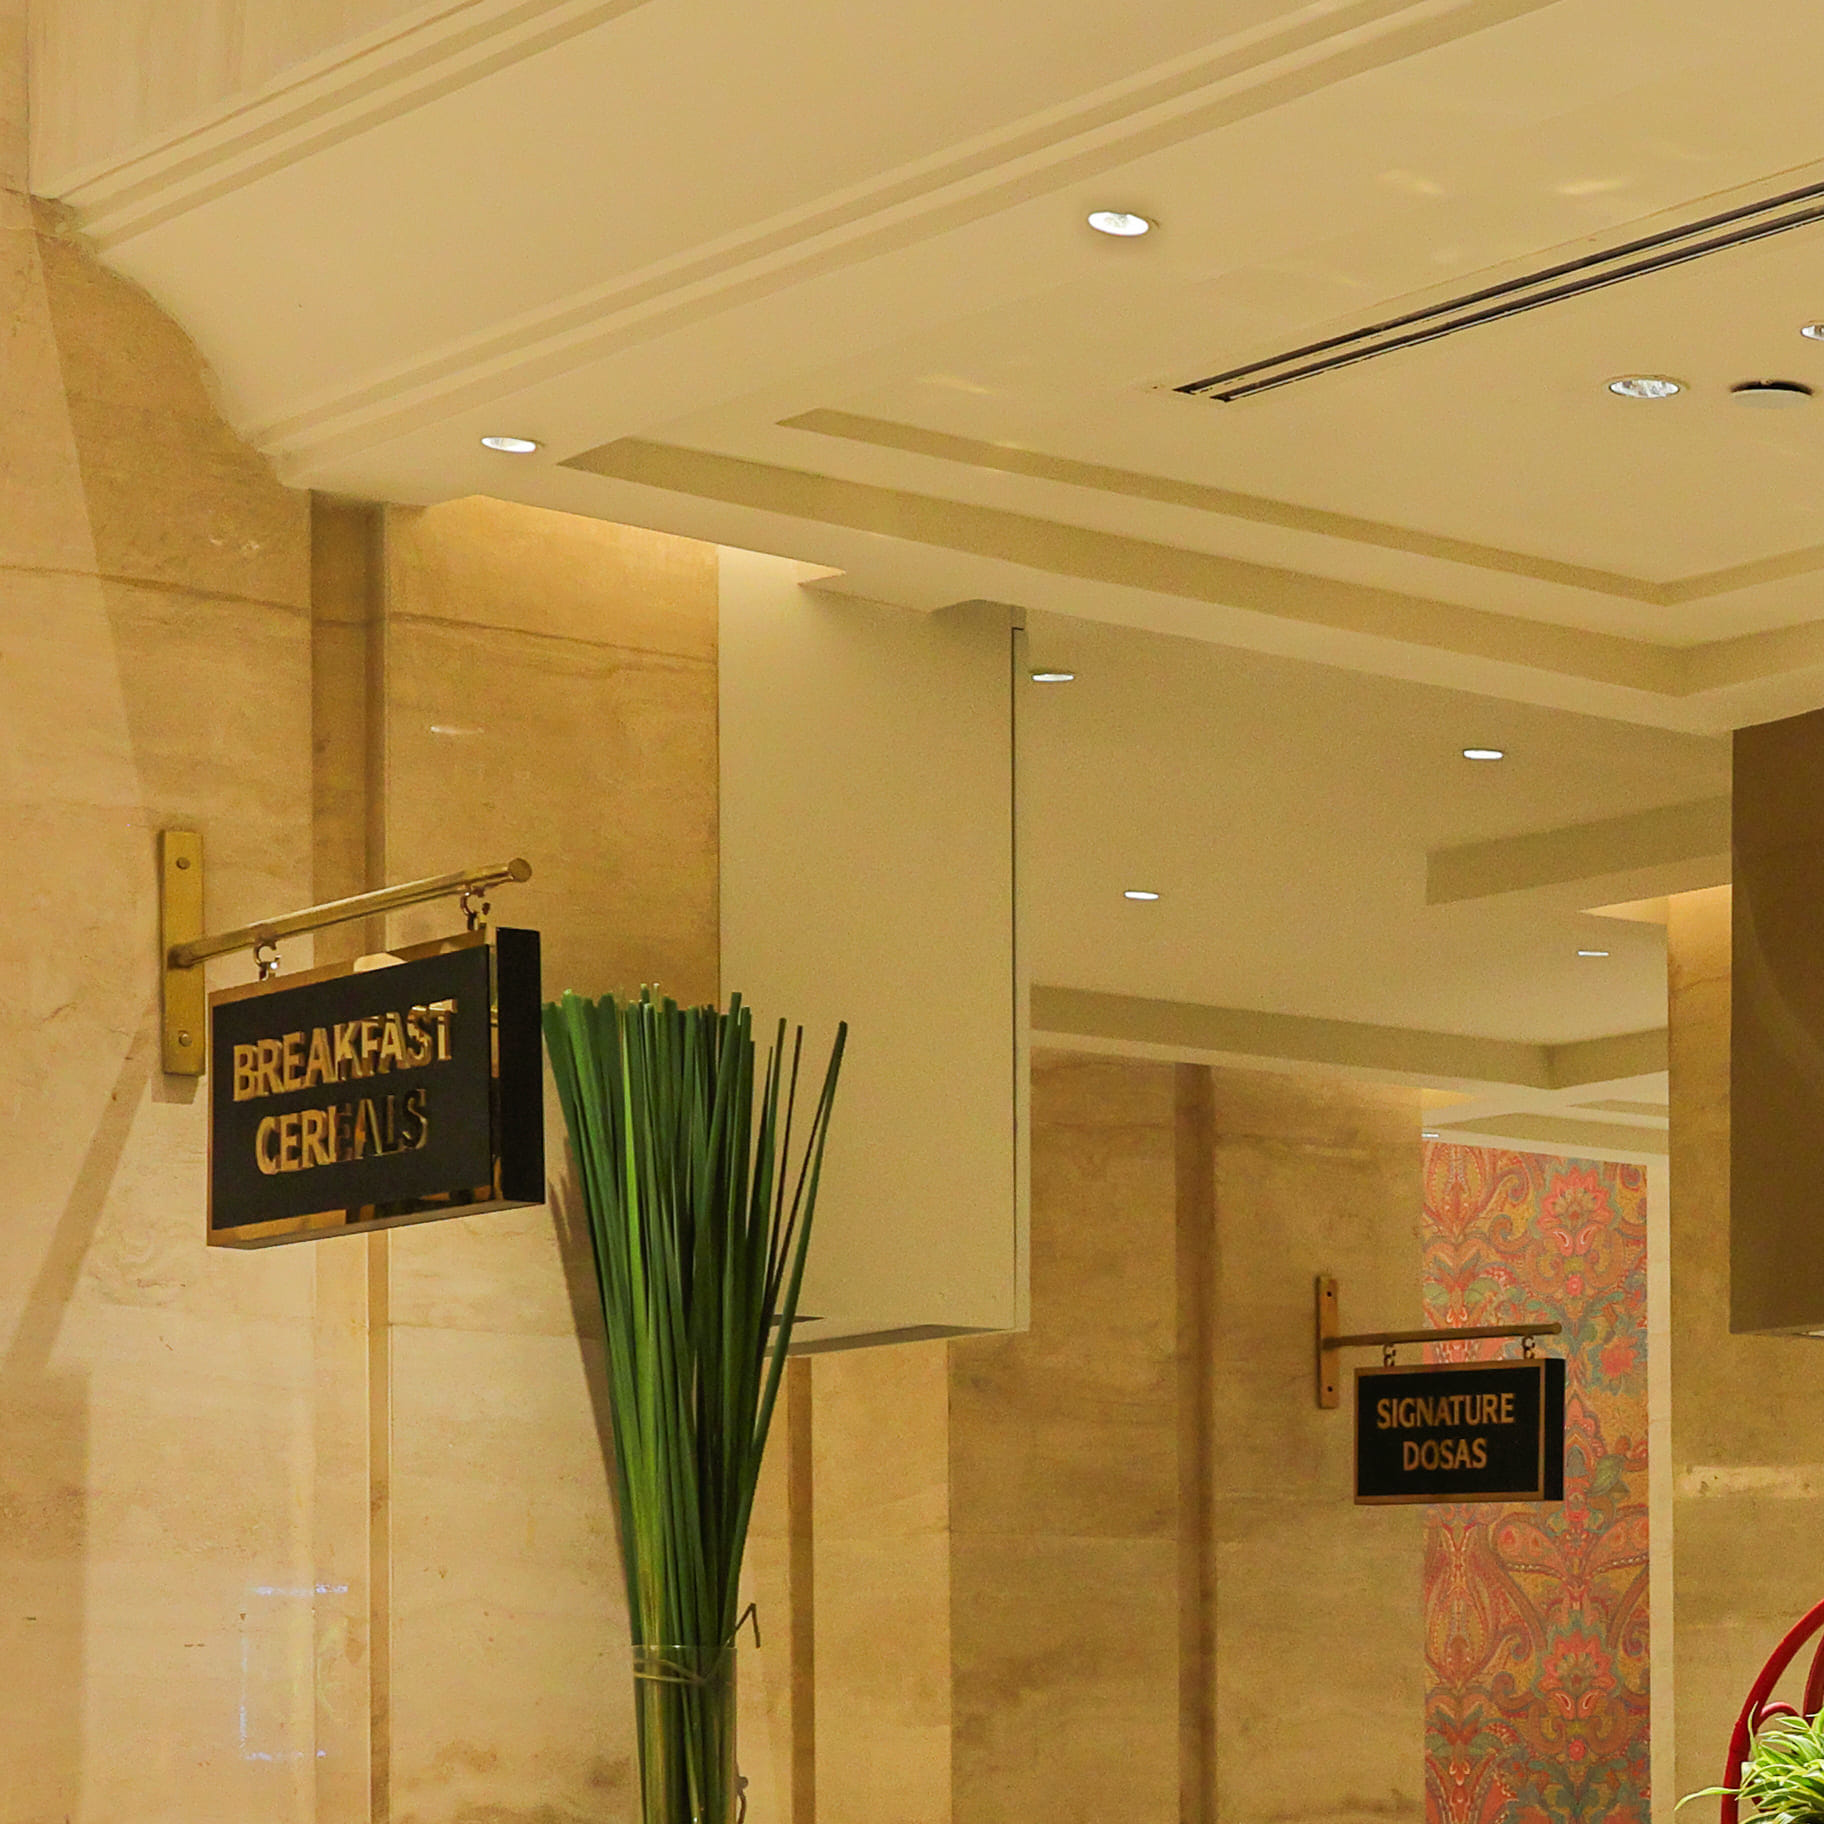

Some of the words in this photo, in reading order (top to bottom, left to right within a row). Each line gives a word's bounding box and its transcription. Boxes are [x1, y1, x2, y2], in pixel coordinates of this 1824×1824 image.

[232, 998, 459, 1102] BREAKFAST
[255, 1089, 428, 1175] CEREALS
[1376, 1392, 1515, 1430] SIGNATURE
[1402, 1438, 1488, 1471] DOSAS
